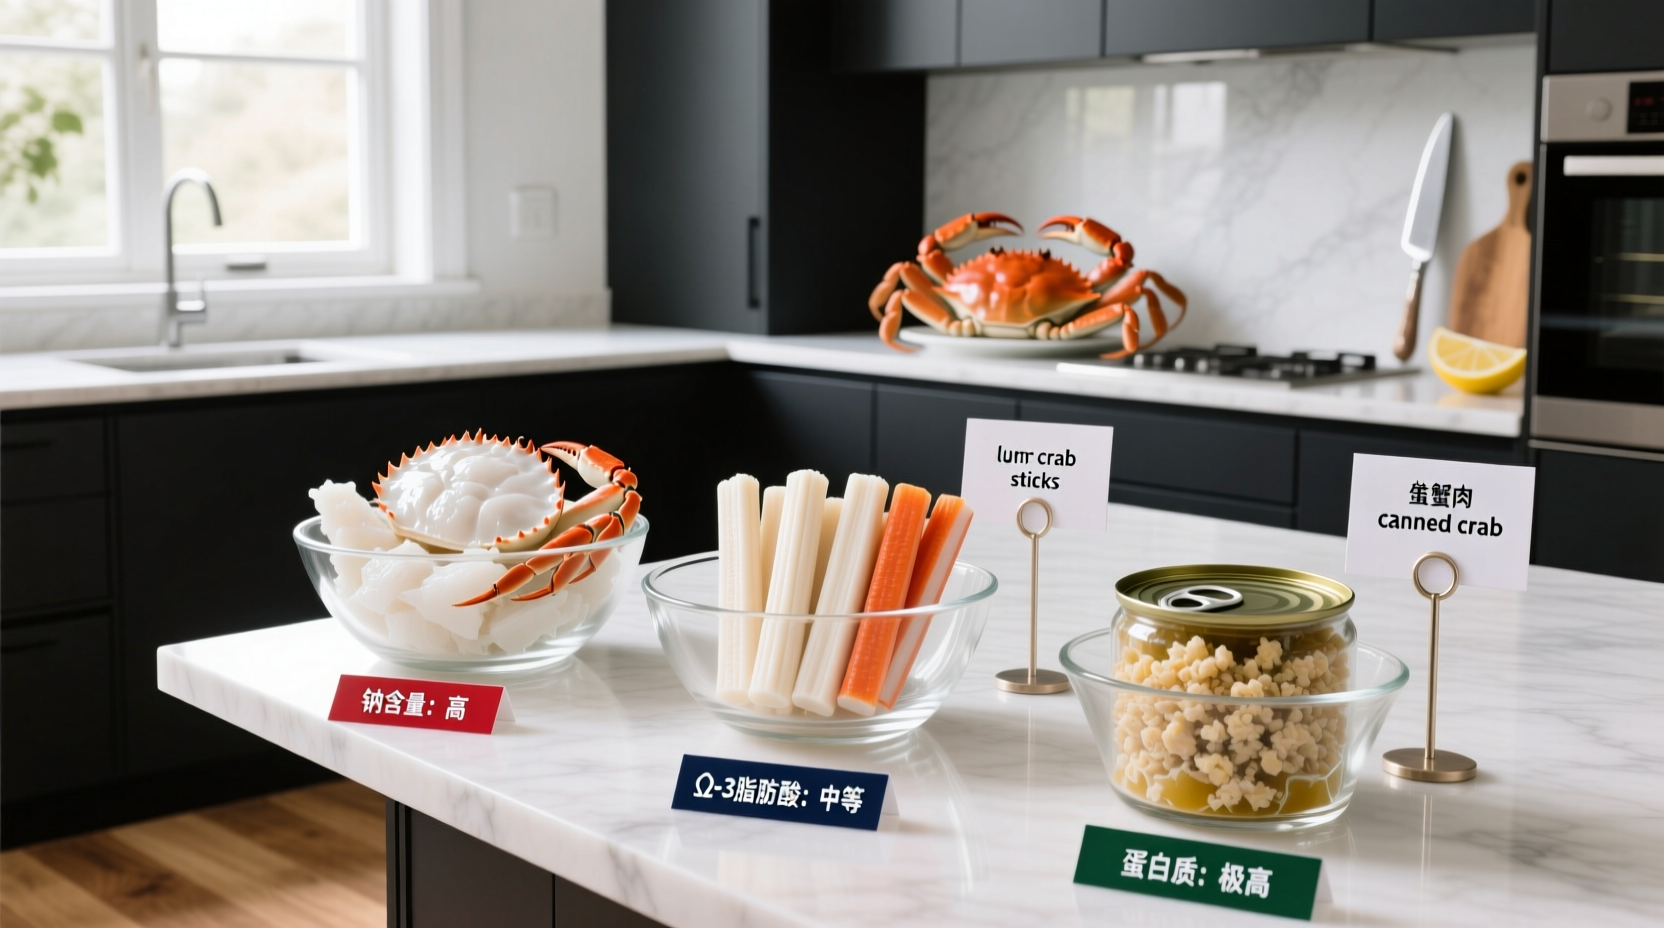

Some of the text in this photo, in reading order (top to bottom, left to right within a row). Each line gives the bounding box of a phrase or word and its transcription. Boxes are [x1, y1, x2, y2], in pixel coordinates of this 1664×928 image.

[1037, 449, 1076, 466] crab
[1010, 471, 1060, 489] sticks
[1378, 513, 1503, 537] canned crab
